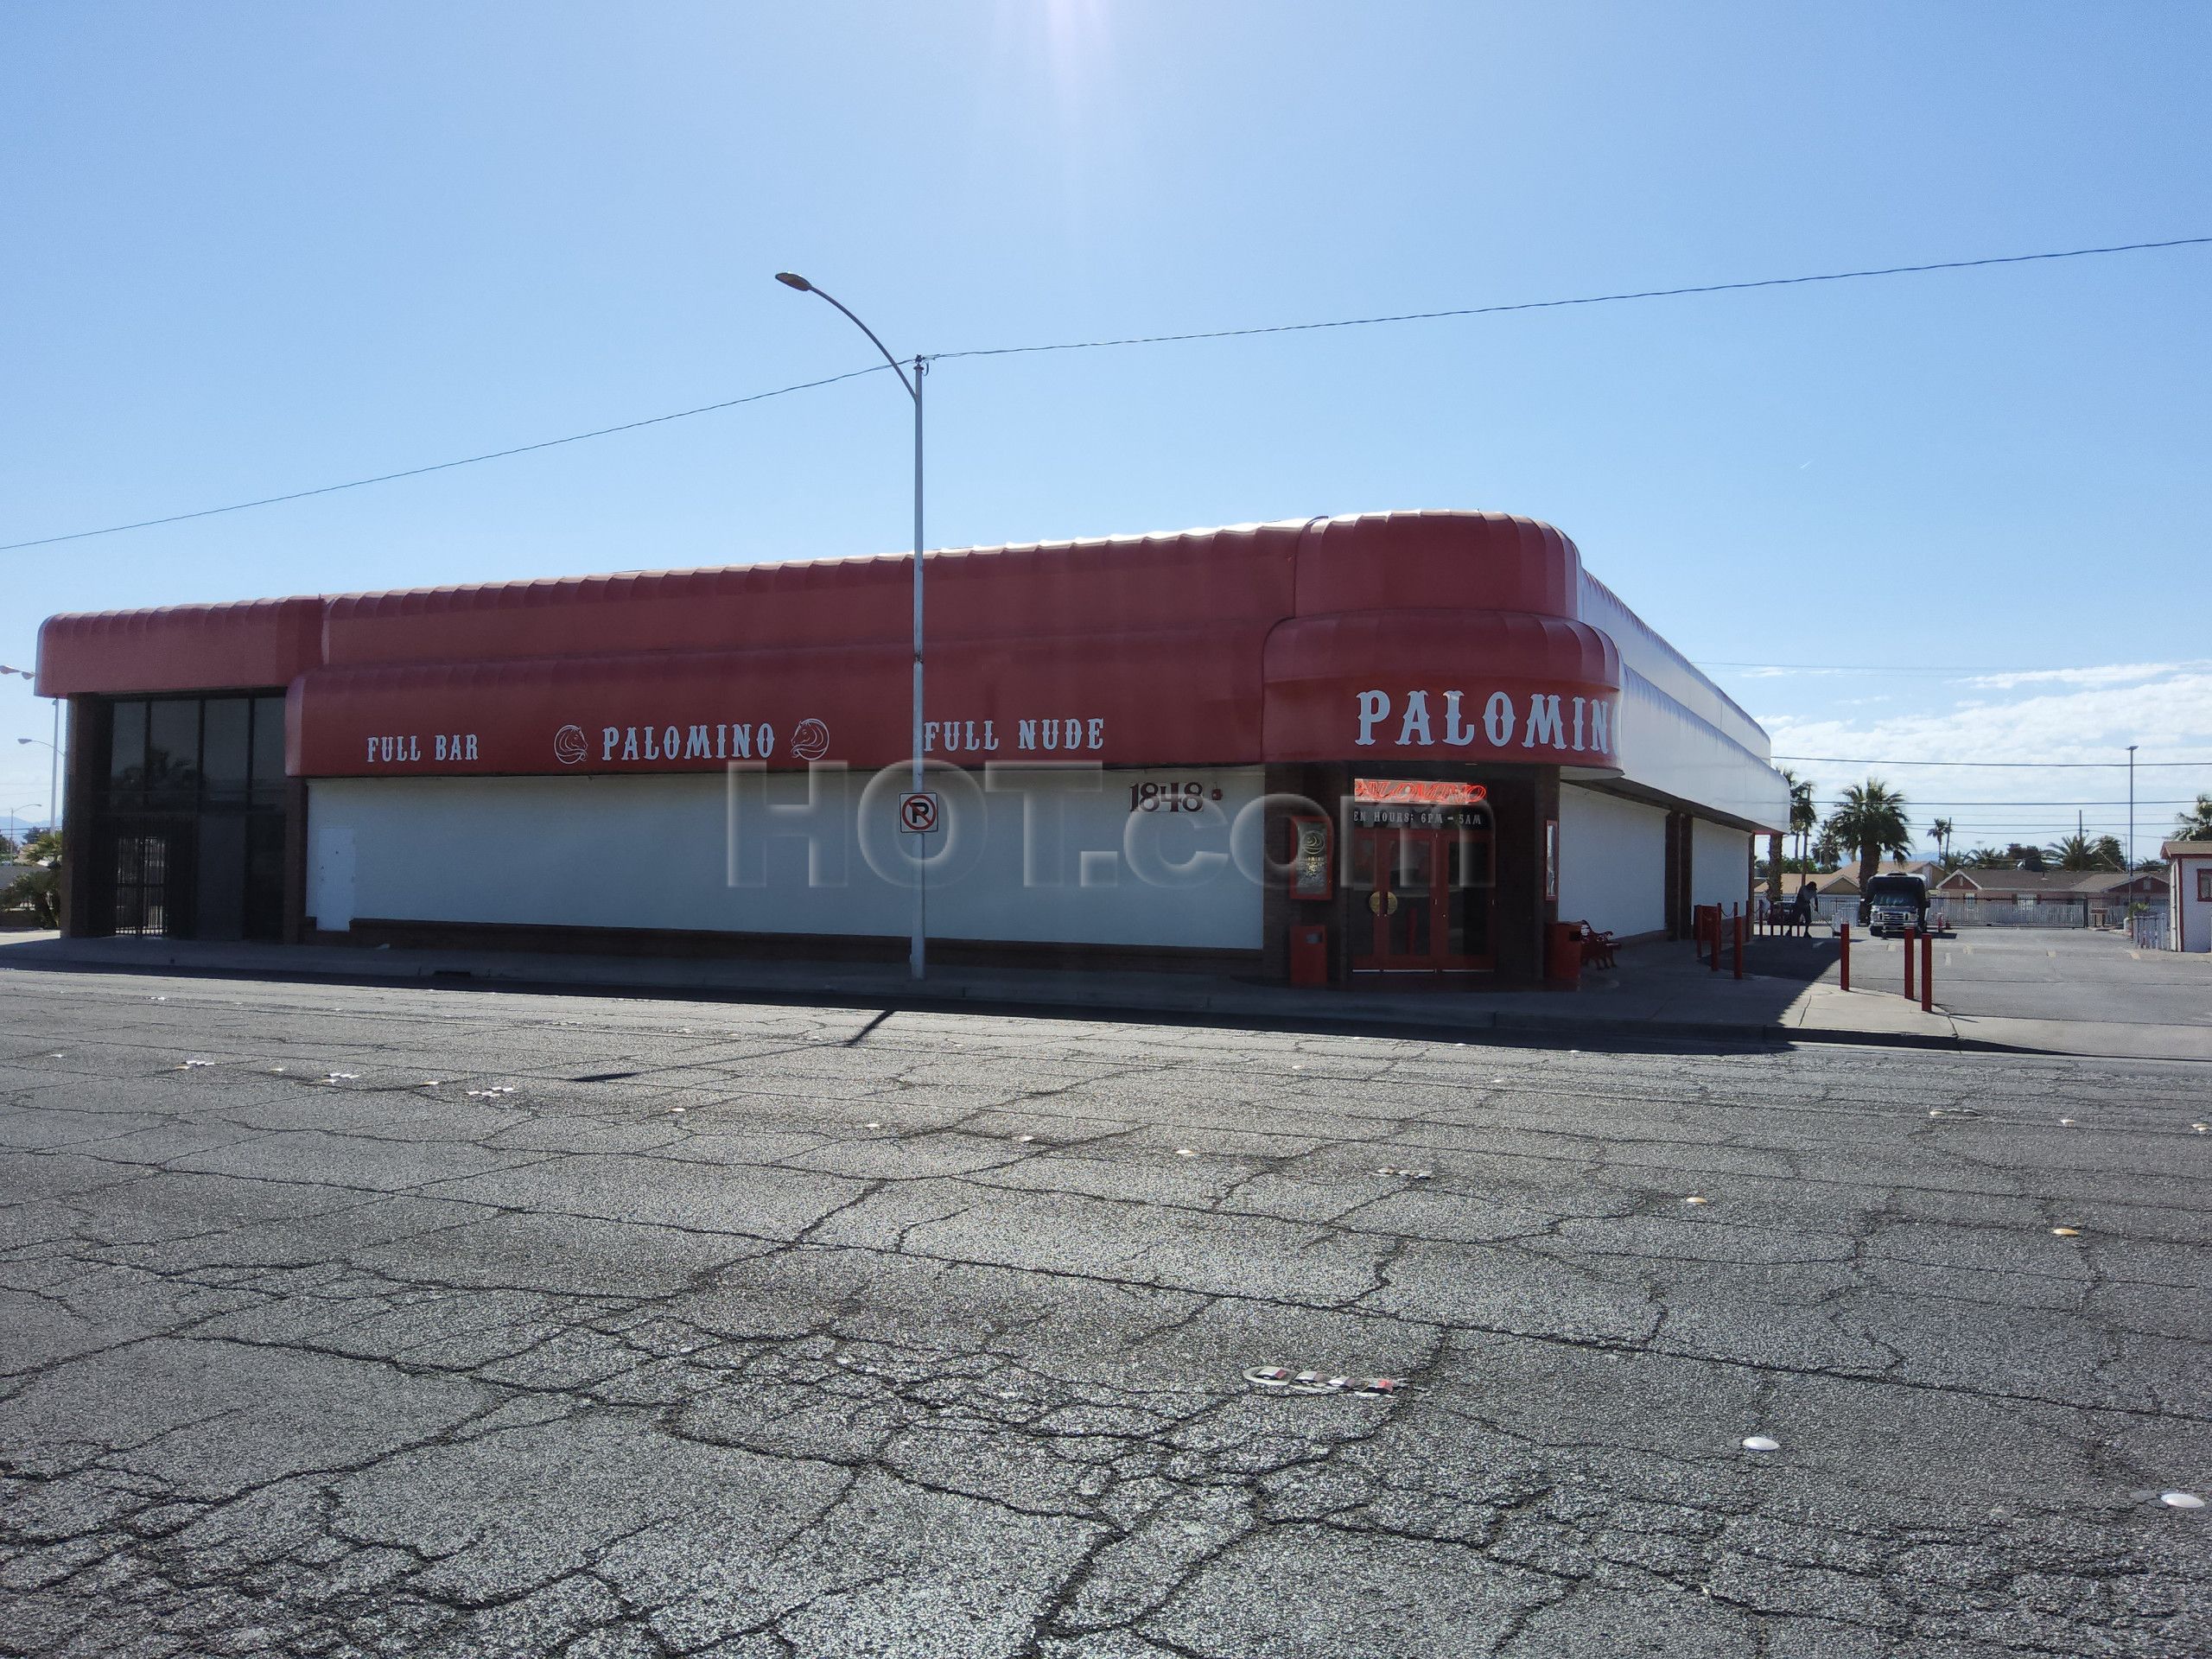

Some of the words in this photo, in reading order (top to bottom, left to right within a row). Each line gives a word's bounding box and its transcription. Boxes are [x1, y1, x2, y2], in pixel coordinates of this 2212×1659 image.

[366, 735, 422, 763] FULL
[434, 734, 479, 761] BAR
[601, 722, 776, 761] PALOMINO
[924, 720, 1000, 752] FULL
[1017, 718, 1104, 751] NUDE
[1129, 781, 1204, 812] 1848
[1374, 811, 1414, 823] HOURS:
[1421, 812, 1444, 824] 6PM
[1459, 813, 1483, 825] 5AM
